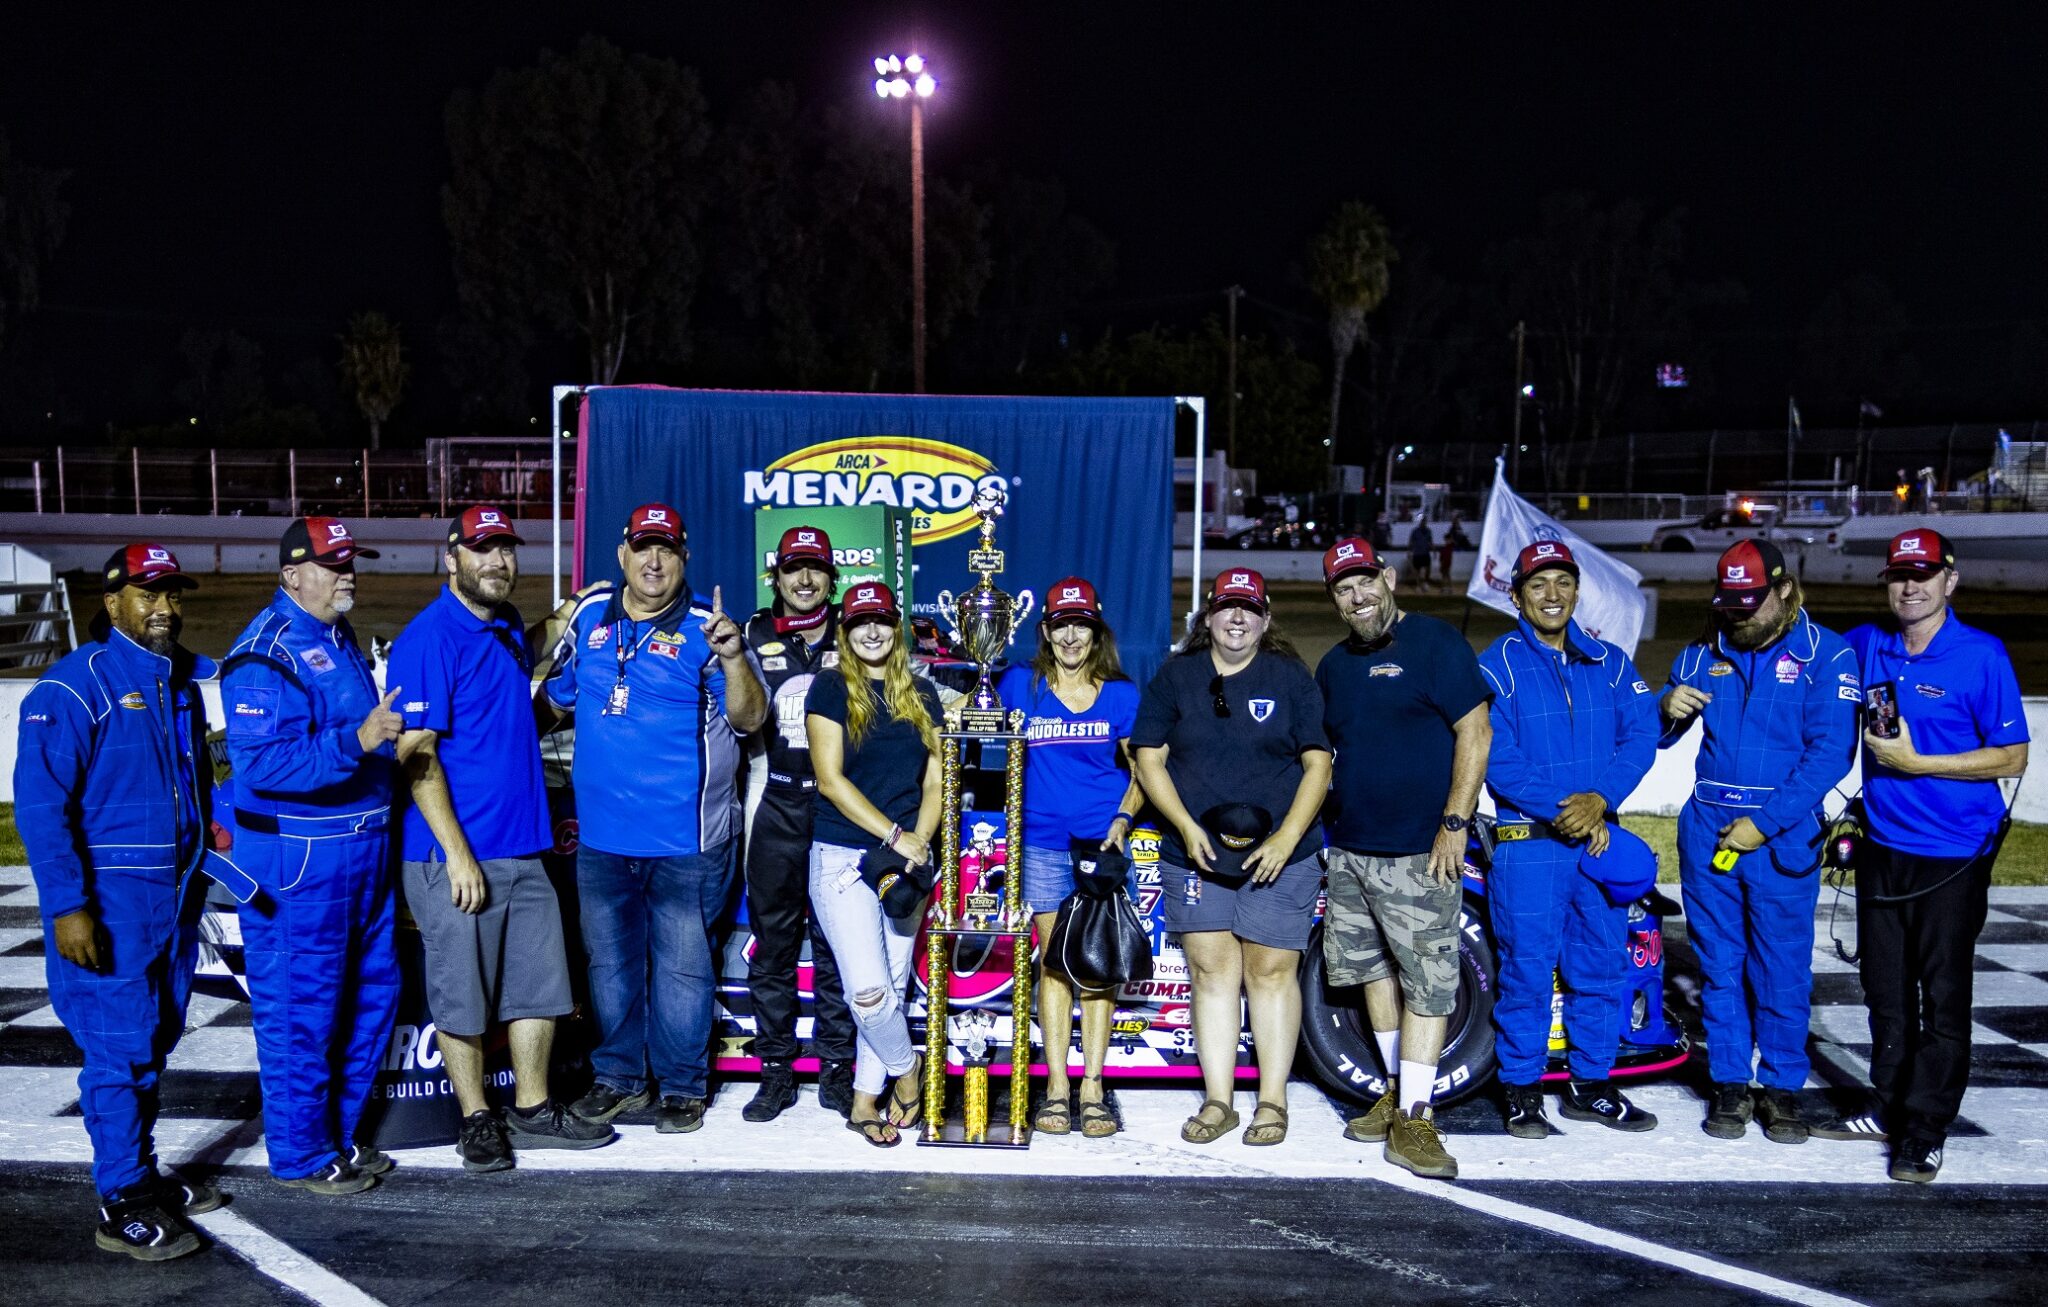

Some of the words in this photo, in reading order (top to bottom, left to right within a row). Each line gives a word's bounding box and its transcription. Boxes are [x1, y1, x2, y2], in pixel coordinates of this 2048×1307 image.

[835, 455, 871, 469] ARCA
[766, 547, 875, 567] MRDS
[896, 520, 905, 620] MENARD
[788, 614, 822, 627] GENERAL
[1028, 722, 1110, 740] HUDDLESTON
[1633, 929, 1661, 968] 50
[1124, 981, 1191, 997] COMP
[386, 1081, 434, 1099] BUILD
